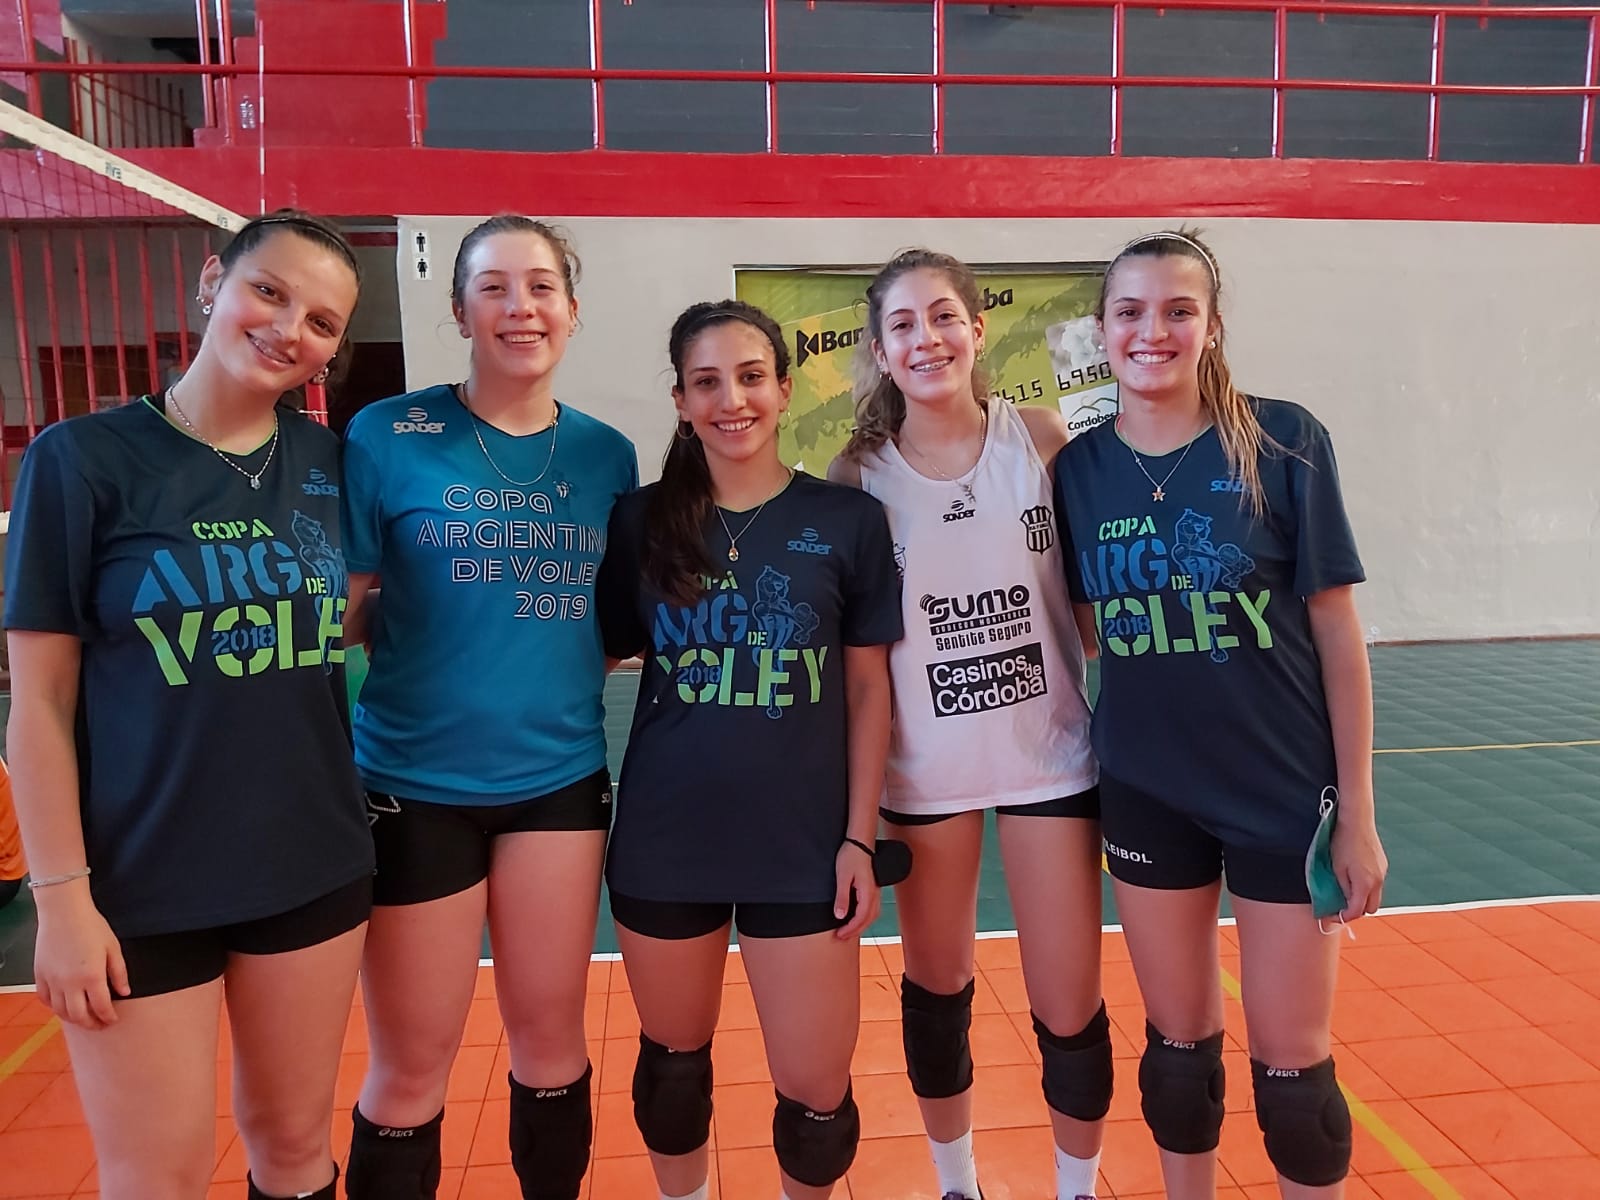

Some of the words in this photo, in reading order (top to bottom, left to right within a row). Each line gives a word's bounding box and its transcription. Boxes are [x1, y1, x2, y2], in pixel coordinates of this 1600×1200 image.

[1057, 360, 1112, 391] 6950
[192, 518, 274, 540] COPA
[416, 518, 603, 553] ARGENTIN
[1098, 515, 1157, 541] COPA
[131, 541, 303, 613] ARG
[305, 577, 328, 595] DE
[452, 557, 504, 583] DE
[510, 555, 595, 586] VOLE
[1171, 575, 1195, 590] DE
[513, 591, 588, 621] 2019
[134, 597, 347, 686] VOLE
[211, 625, 277, 656] 2018
[747, 631, 768, 646] DE
[936, 631, 985, 652] Sentite
[988, 621, 1032, 643] Seguro
[1104, 615, 1152, 638] 2018
[676, 667, 721, 685] 2018
[932, 655, 1028, 687] Casinos
[1024, 663, 1043, 679] de
[936, 675, 1046, 714] Córdoba
[1104, 840, 1153, 864] LEIBOL
